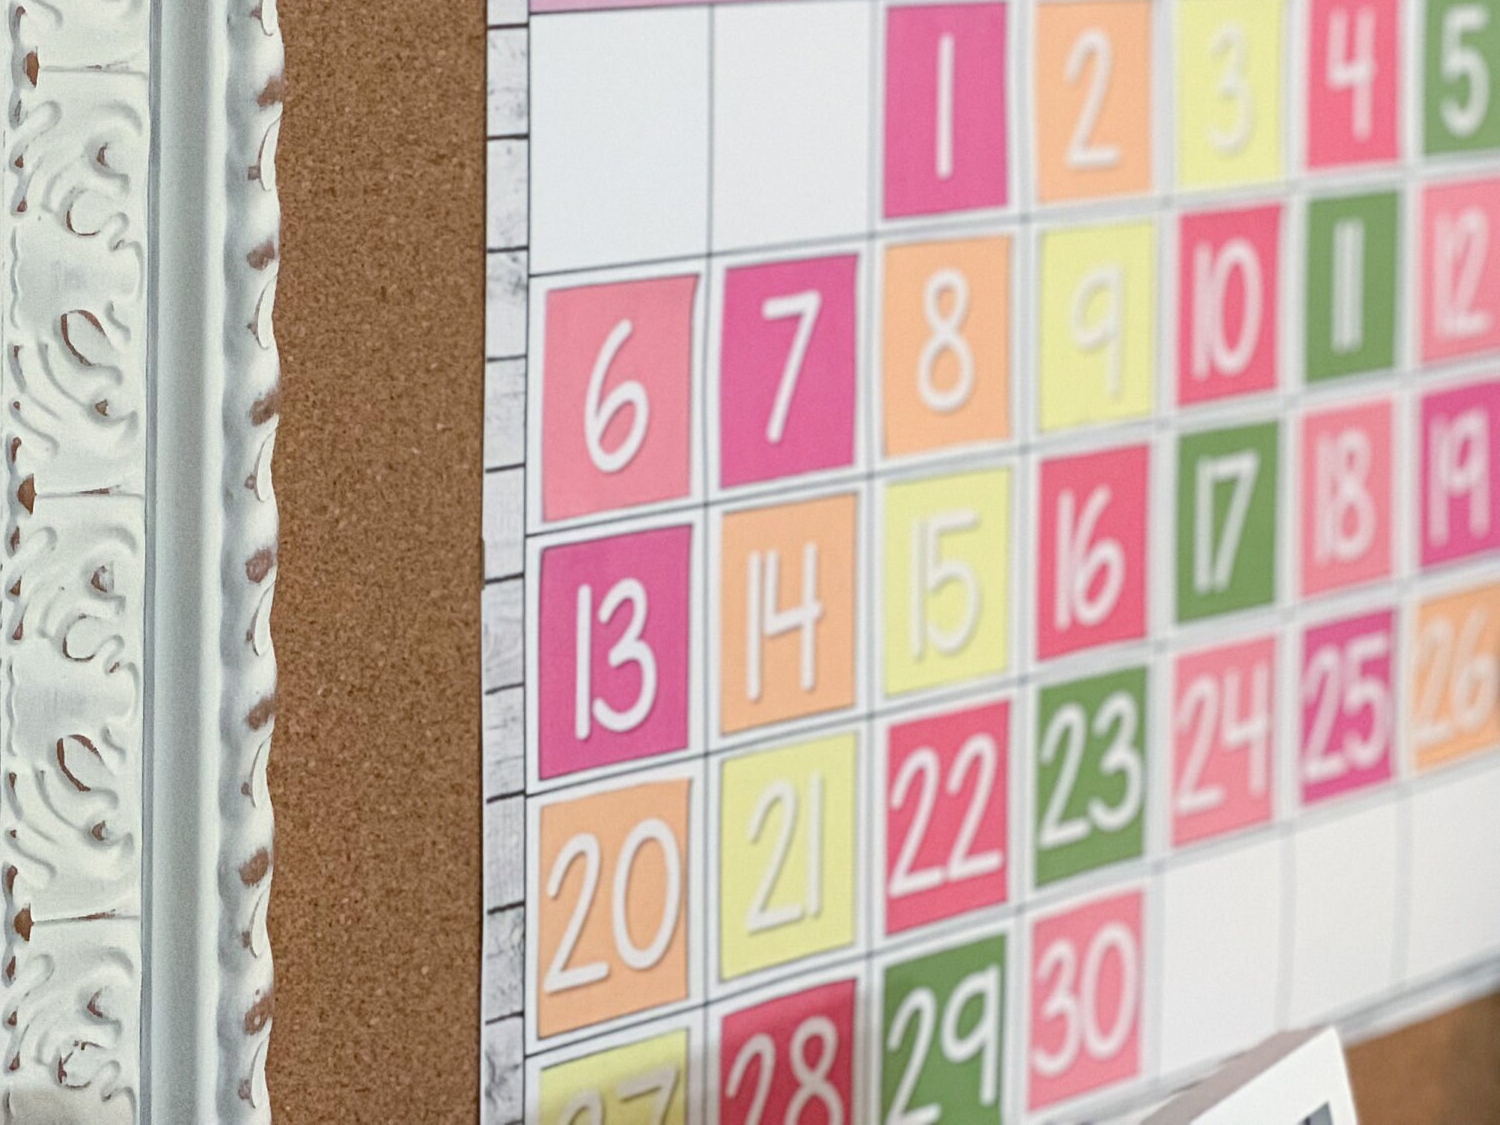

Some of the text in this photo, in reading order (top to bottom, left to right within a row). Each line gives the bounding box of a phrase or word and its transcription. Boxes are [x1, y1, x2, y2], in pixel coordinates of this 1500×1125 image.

[936, 4, 1490, 180] 1 2 3 4 5
[582, 318, 651, 473] 6
[761, 290, 822, 444] 7
[917, 269, 975, 412] 8
[1069, 262, 1124, 400] 9
[1191, 238, 1264, 381] 10
[1433, 206, 1494, 338] 12
[575, 577, 658, 739] 13
[745, 543, 824, 701] 14
[910, 509, 983, 660] 15
[1055, 488, 1126, 631] 16
[1194, 450, 1260, 594] 17
[1314, 425, 1376, 564] 18
[542, 598, 1496, 993] 20 21 22 23 24 25 26
[725, 924, 1139, 1125] 28 29 30
